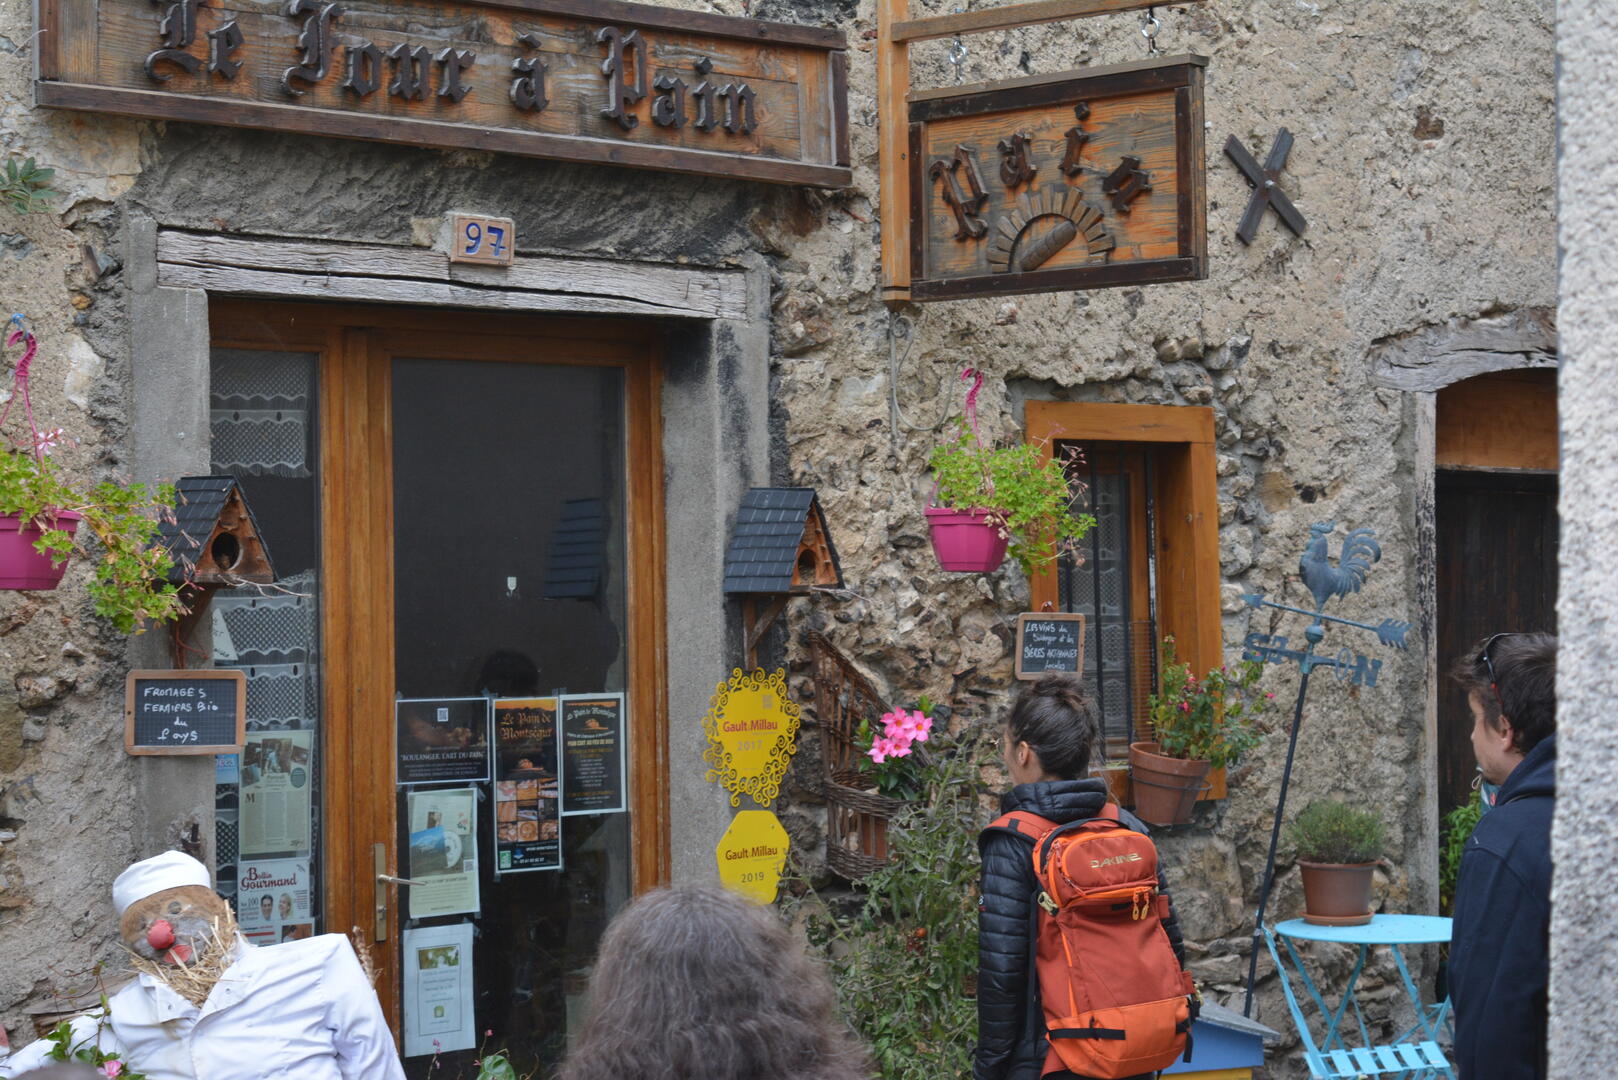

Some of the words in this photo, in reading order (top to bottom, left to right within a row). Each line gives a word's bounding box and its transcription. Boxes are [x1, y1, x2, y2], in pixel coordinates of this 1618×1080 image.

[144, 0, 245, 82] Le
[598, 26, 759, 137] Pain
[928, 101, 1153, 244] Pain
[465, 222, 507, 256] 97
[143, 686, 207, 699] FROMAGES
[143, 702, 193, 713] FERMIERS
[173, 716, 188, 727] du
[723, 720, 748, 733] Gault
[750, 719, 778, 731] Millau
[737, 740, 764, 751] 2017
[725, 848, 748, 861] Gault
[751, 846, 778, 858] Millau
[1090, 853, 1142, 869] DAKINE
[239, 872, 297, 892] Gourmand
[741, 872, 765, 883] 2019
